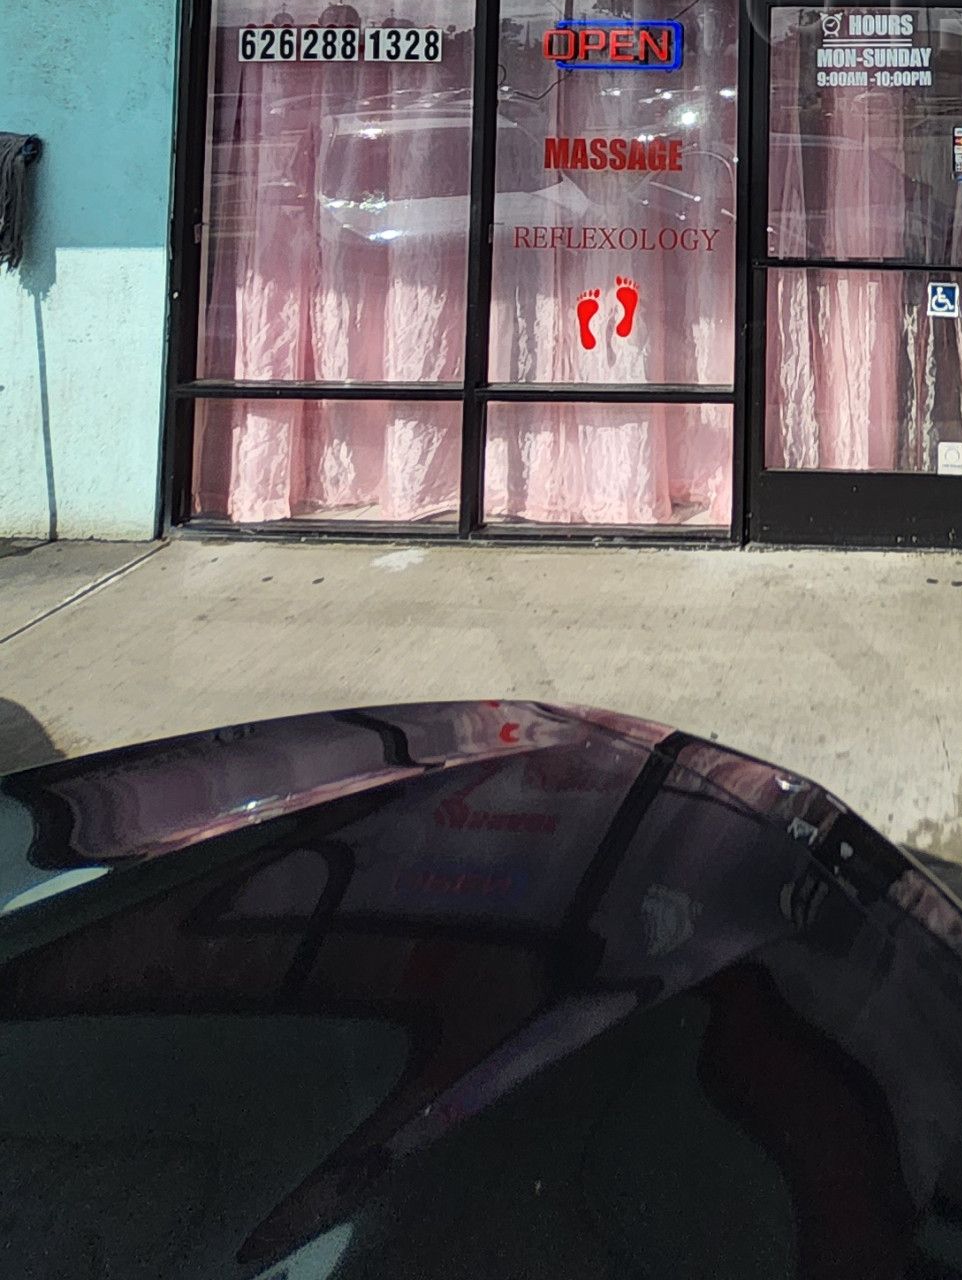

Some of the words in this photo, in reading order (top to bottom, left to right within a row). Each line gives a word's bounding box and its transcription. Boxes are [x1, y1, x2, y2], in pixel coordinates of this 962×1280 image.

[848, 14, 914, 36] HOURS
[241, 29, 295, 60] 626
[302, 29, 357, 60] 288
[369, 29, 440, 60] 1328
[542, 29, 671, 62] OPEN
[816, 47, 932, 68] MON-SUNDAY
[816, 71, 868, 87] 9:00AM
[543, 137, 683, 172] MASSAGE
[513, 226, 720, 251] REFLEXOLOGY
